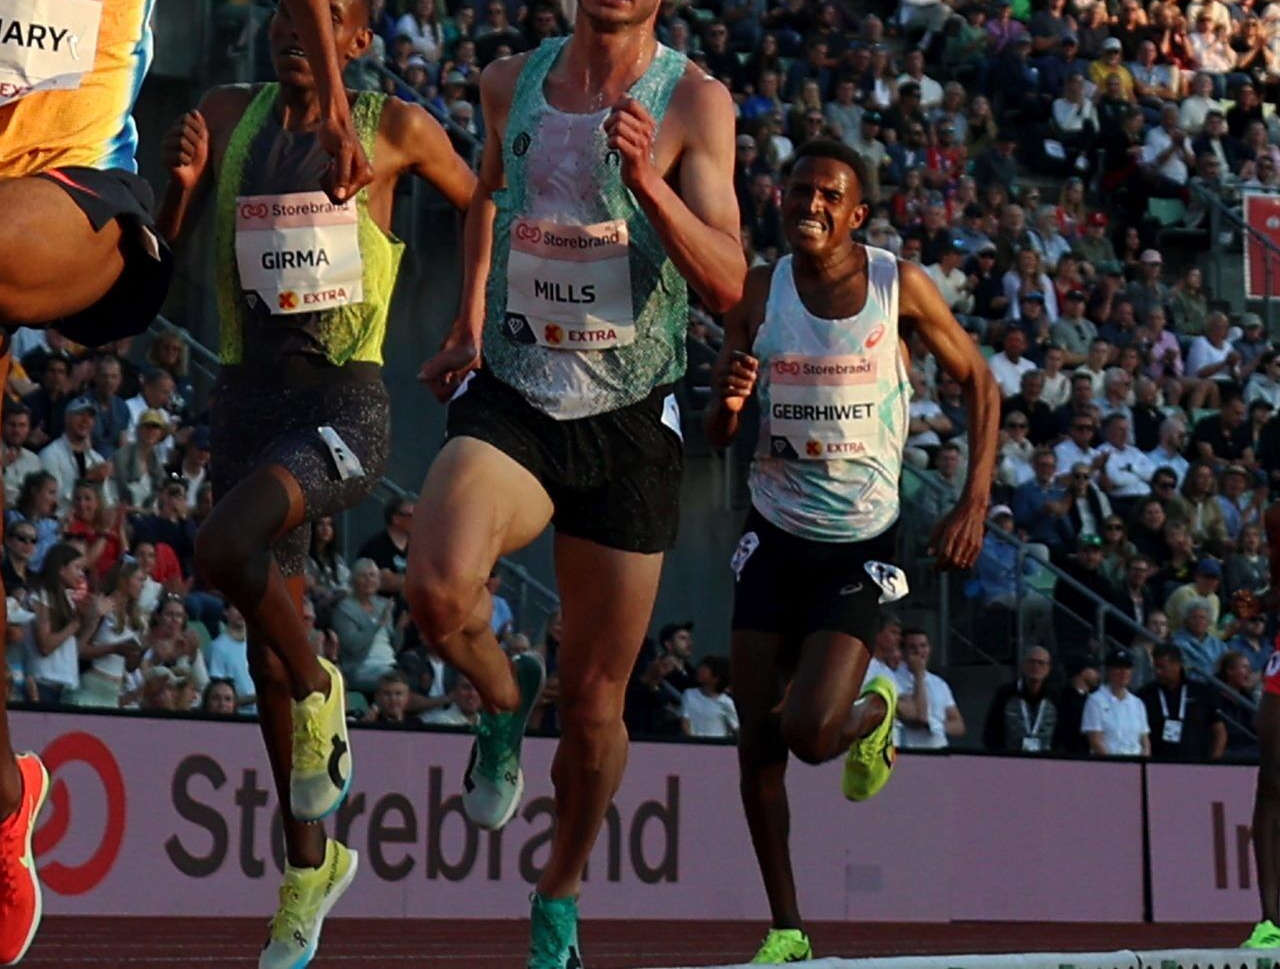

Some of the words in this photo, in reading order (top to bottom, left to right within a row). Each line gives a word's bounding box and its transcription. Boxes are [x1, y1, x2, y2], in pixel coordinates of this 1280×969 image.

[543, 225, 620, 249] Storebrand
[261, 249, 330, 270] GIRMA
[302, 288, 347, 304] EXTRA
[534, 279, 596, 304] MILLS
[568, 329, 617, 342] EXTRA
[773, 402, 874, 421] GEBRHIWET
[826, 442, 865, 453] EXTRA
[164, 752, 680, 884] Strebrand
